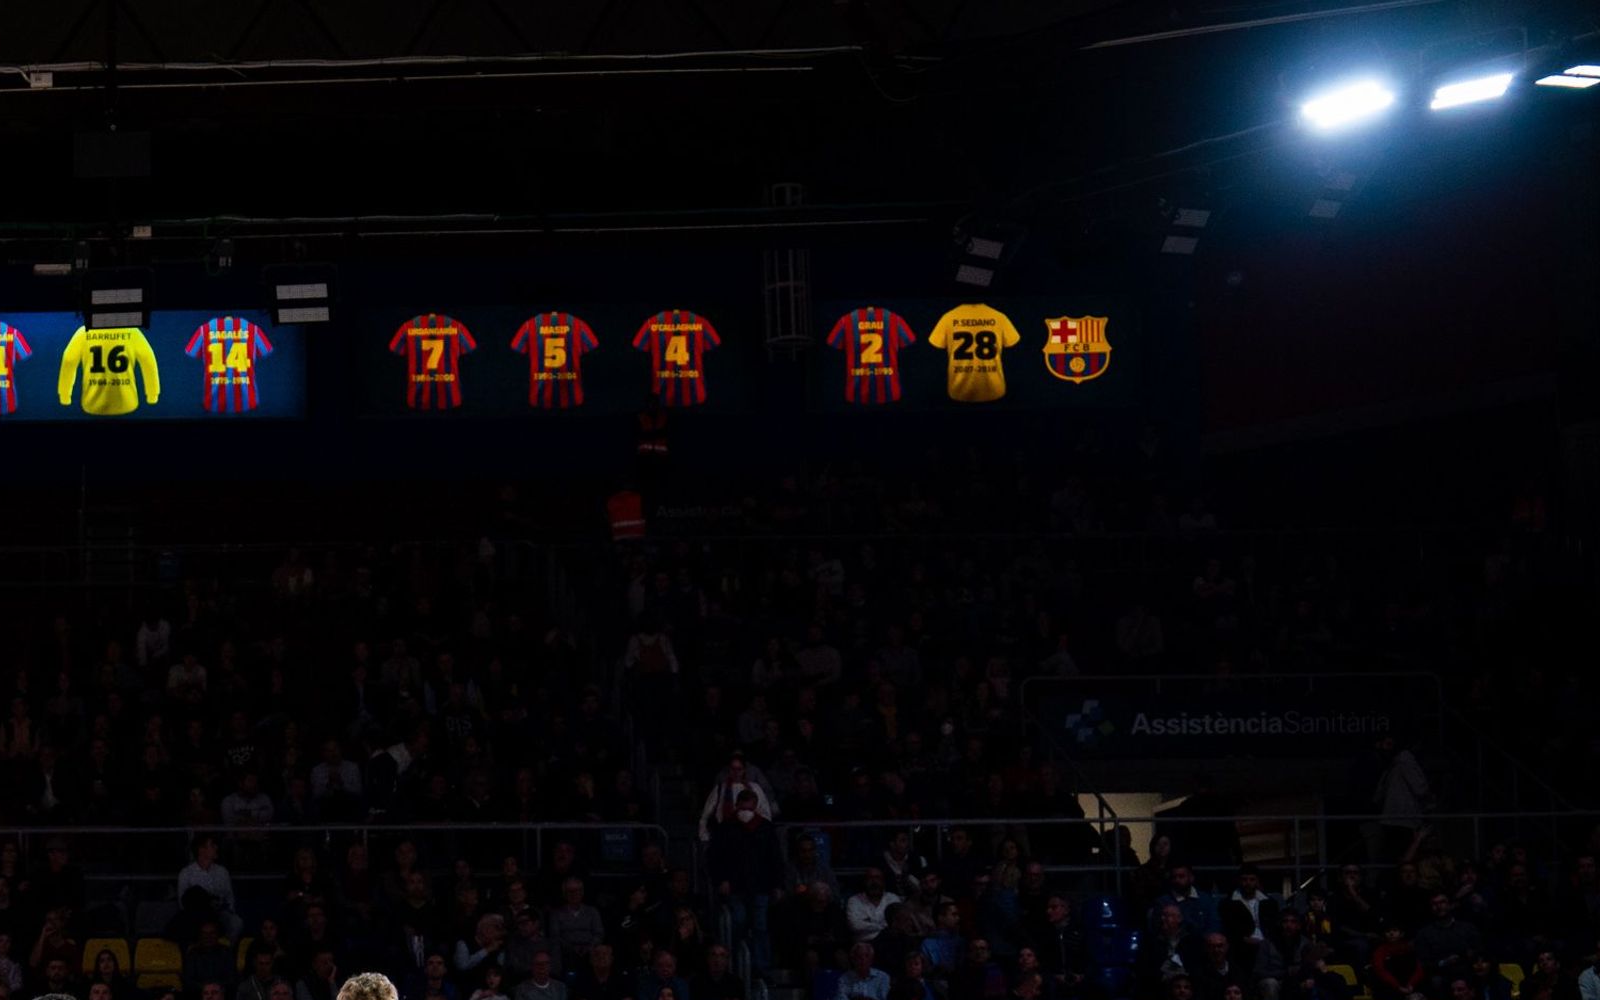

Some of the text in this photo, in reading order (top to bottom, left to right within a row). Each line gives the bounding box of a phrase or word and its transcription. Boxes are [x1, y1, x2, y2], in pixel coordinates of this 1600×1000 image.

[86, 332, 132, 341] BARRUFET
[539, 325, 570, 335] MASIP
[650, 323, 703, 332] O'CALLAGHAN
[89, 345, 130, 374] 16
[208, 342, 251, 373] 14
[421, 339, 444, 369] 7
[544, 337, 567, 368] 5
[665, 335, 690, 365] 4
[860, 333, 883, 363] 2
[952, 331, 998, 360] 28
